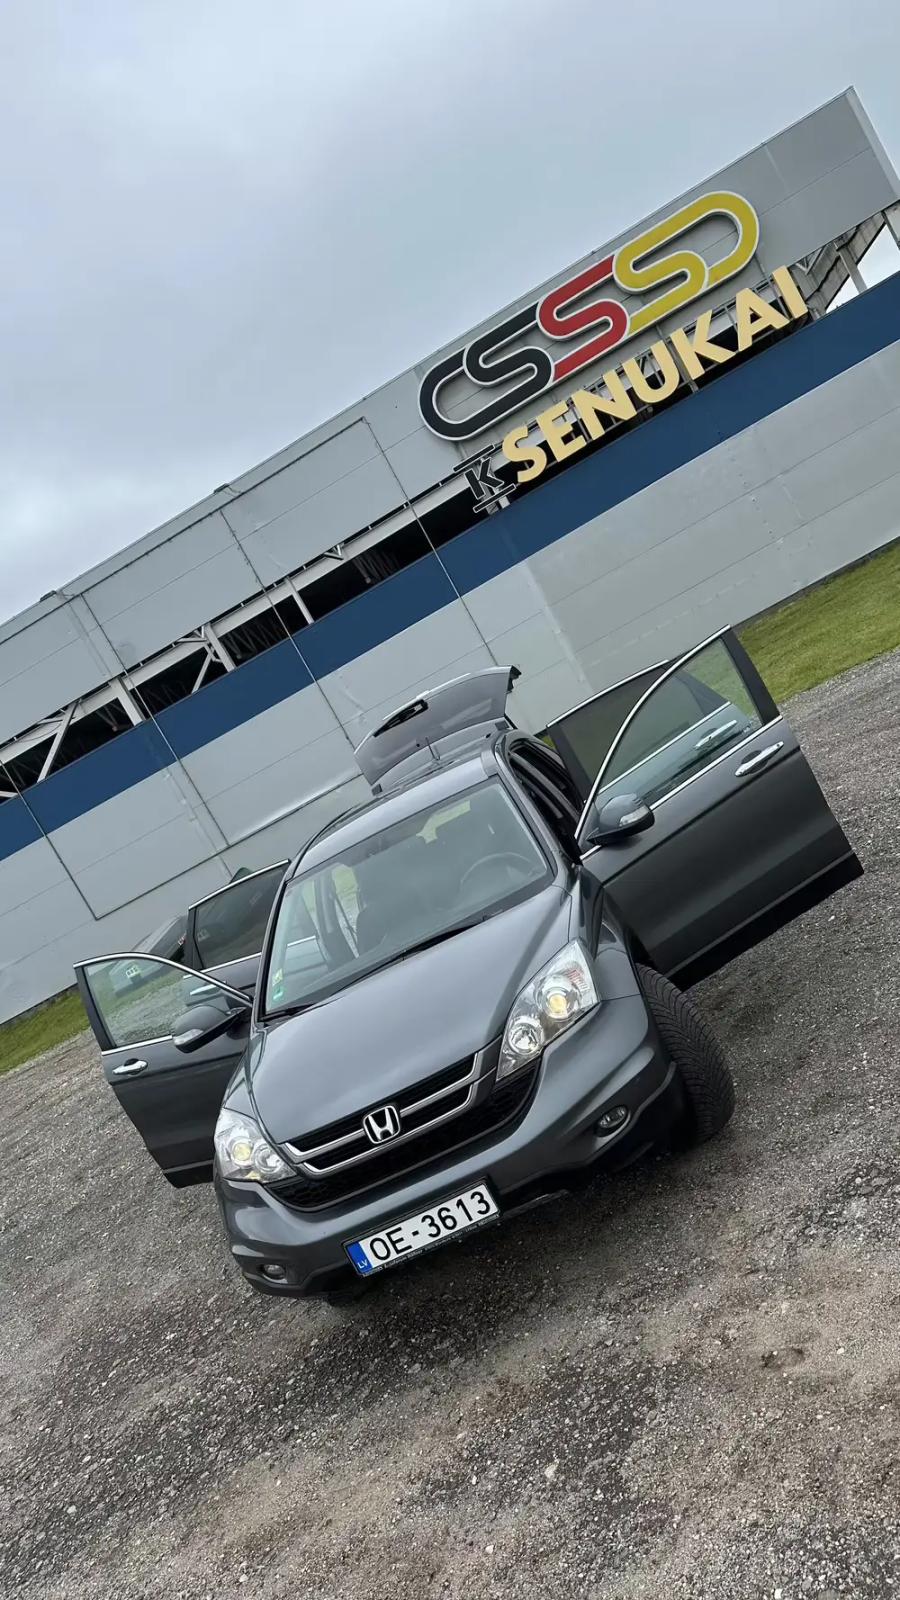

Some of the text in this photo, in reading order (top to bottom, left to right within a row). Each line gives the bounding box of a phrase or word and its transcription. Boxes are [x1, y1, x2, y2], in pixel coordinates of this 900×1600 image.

[501, 265, 808, 483] SENUKAI
[357, 1259, 369, 1269] LV
[369, 1190, 491, 1261] OE-3613
